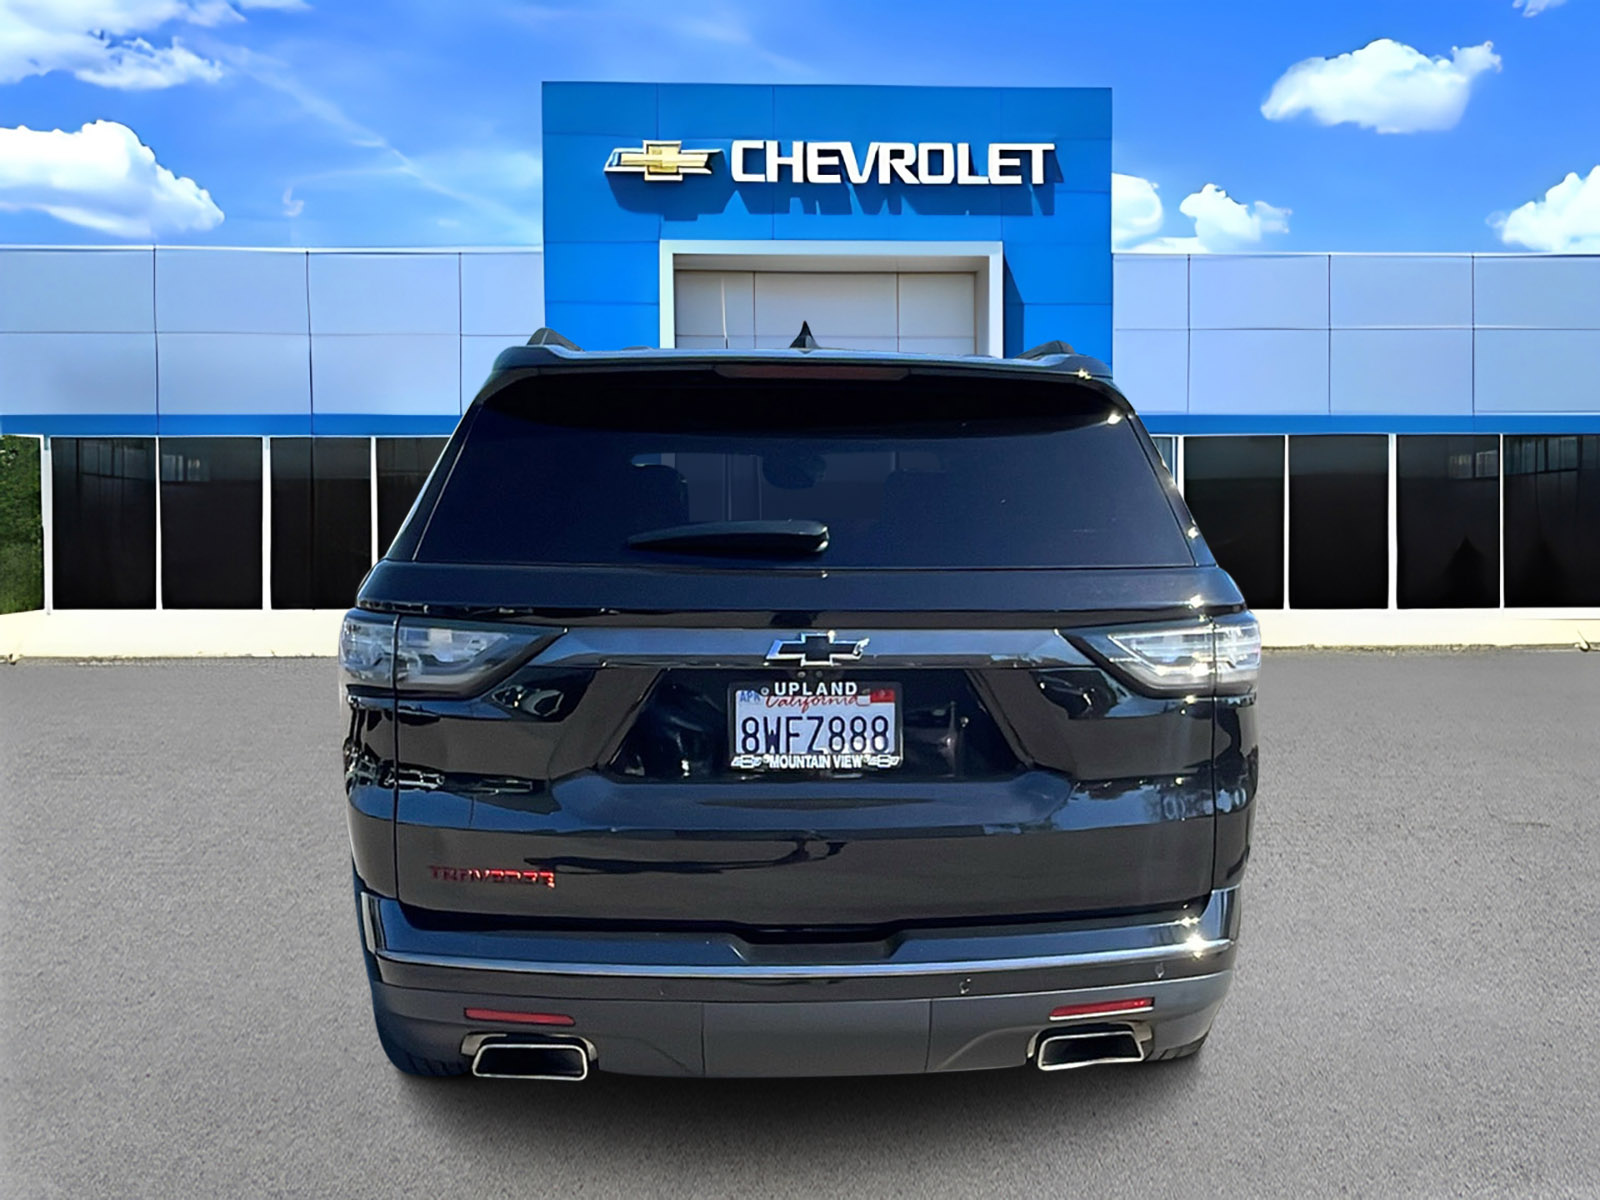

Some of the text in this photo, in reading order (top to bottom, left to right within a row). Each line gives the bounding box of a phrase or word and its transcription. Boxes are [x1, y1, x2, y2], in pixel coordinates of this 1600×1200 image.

[731, 140, 1055, 185] CHEVROLET
[774, 681, 858, 696] UPLAND
[741, 715, 889, 754] 8WFZ888
[769, 754, 864, 769] MOUNTAIN VIEW
